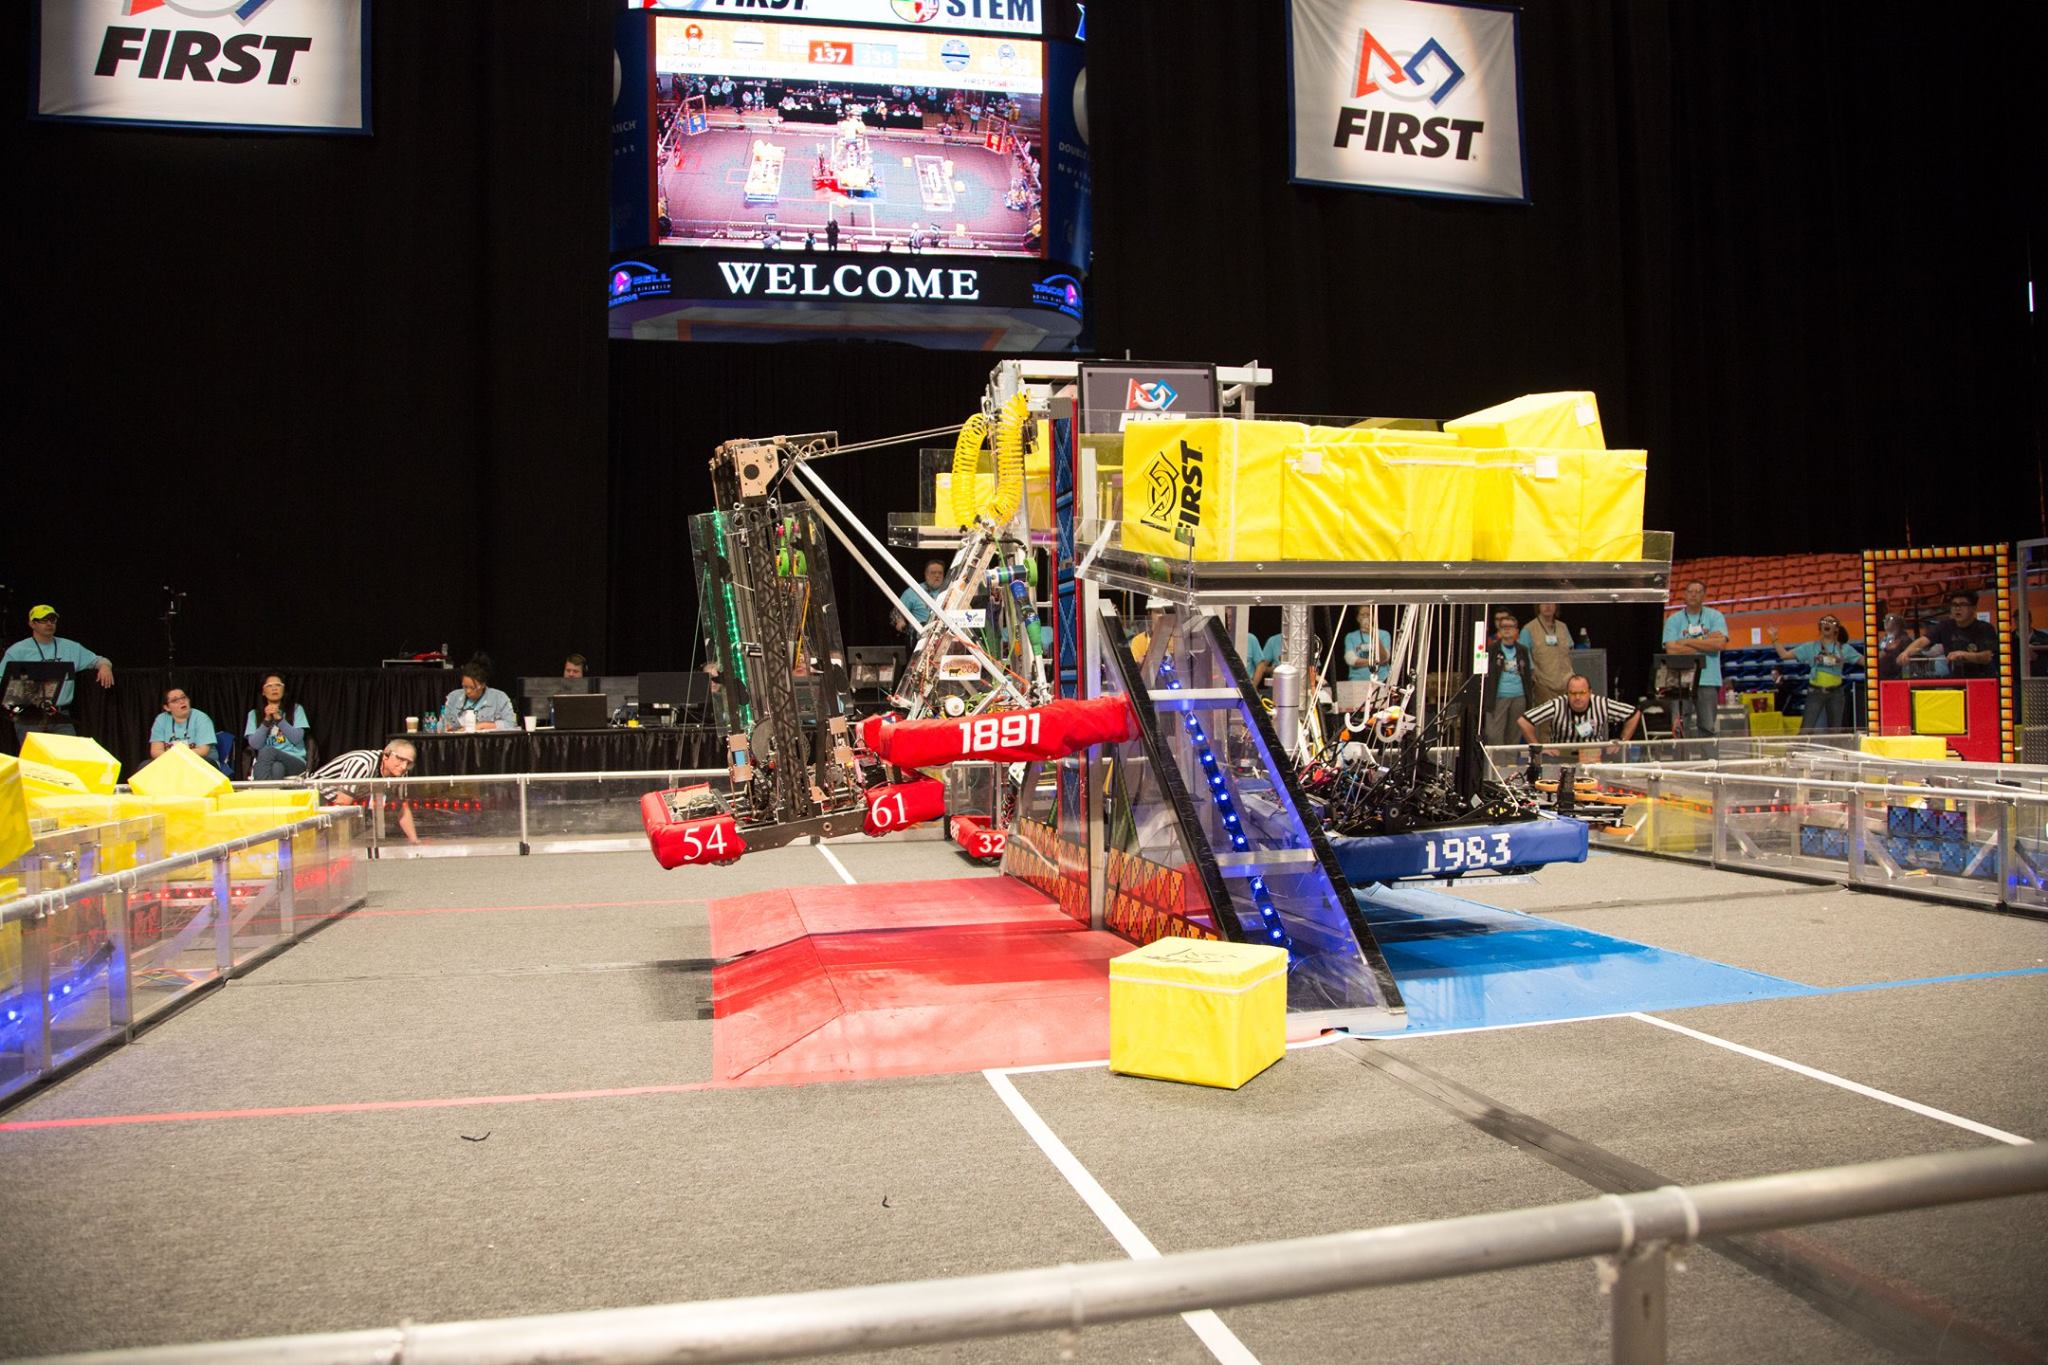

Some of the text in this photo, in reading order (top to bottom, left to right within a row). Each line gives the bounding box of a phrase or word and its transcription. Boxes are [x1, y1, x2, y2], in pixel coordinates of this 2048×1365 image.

[94, 26, 312, 85] FIRST
[814, 47, 847, 64] 137
[1333, 107, 1484, 160] FIRST
[718, 261, 980, 300] WELCOME
[959, 713, 1041, 753] 1891
[871, 793, 908, 829] 61
[682, 824, 728, 861] 54
[1422, 832, 1512, 874] 1983
